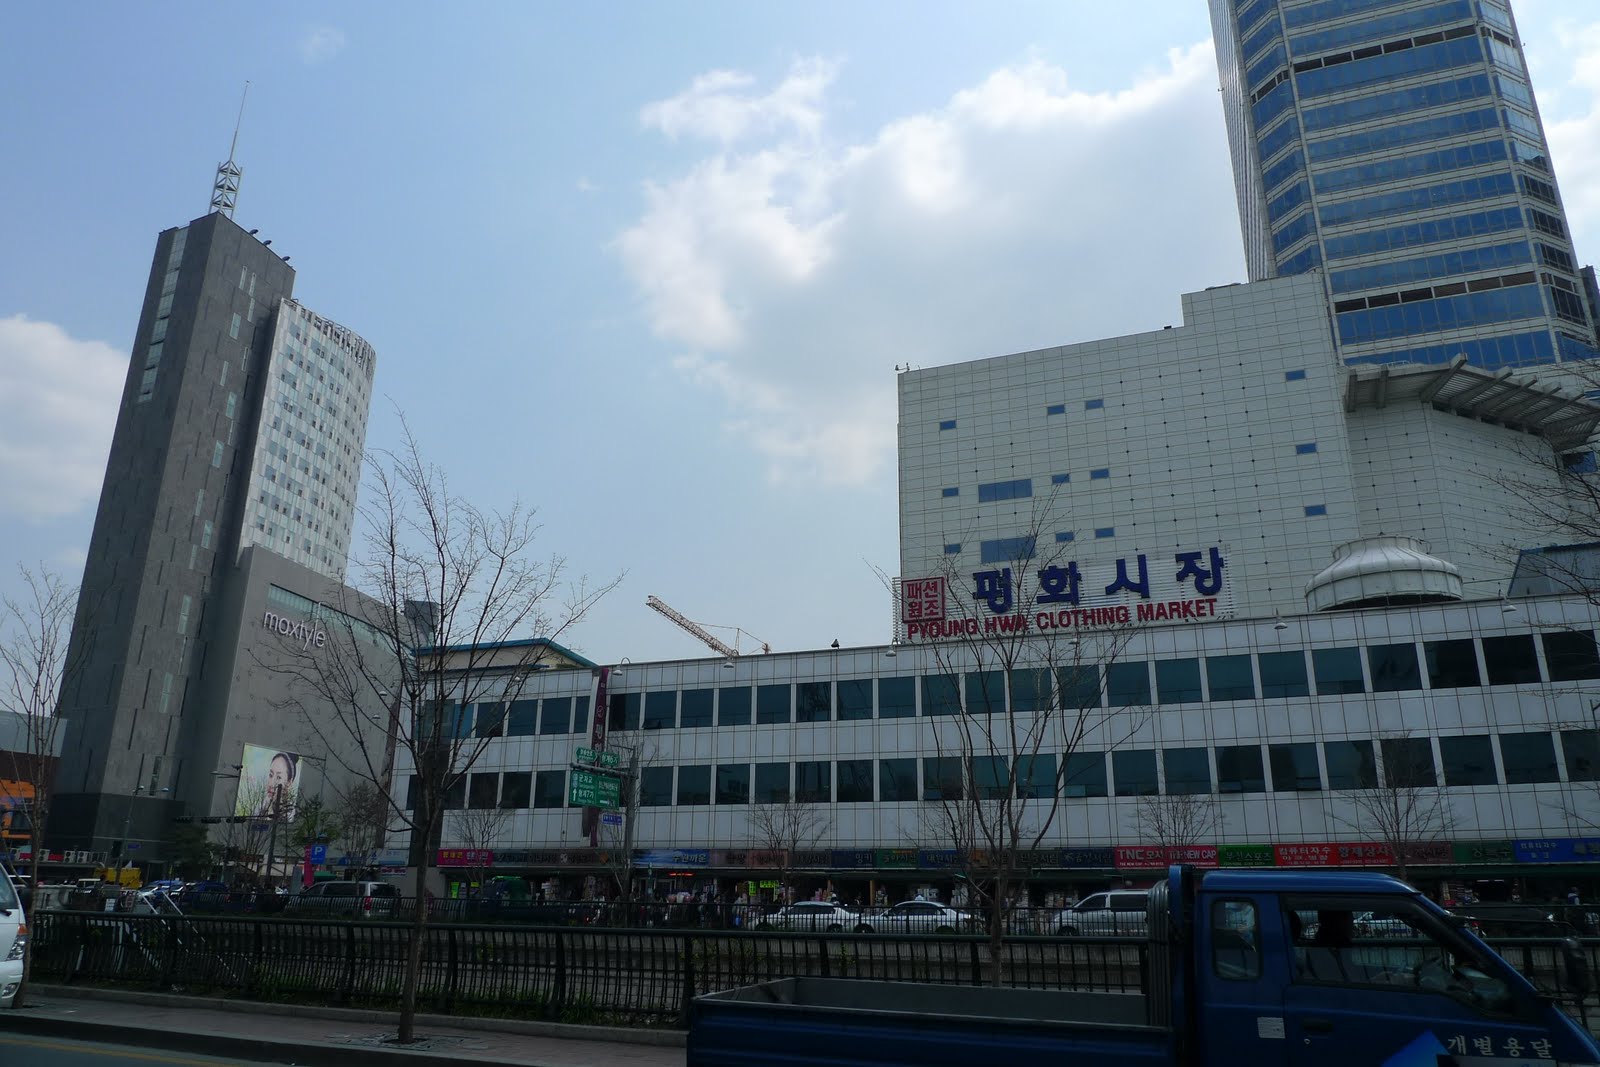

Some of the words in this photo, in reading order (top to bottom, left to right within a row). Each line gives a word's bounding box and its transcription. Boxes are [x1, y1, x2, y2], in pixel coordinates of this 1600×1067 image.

[973, 547, 1224, 614] 평화시장
[907, 581, 938, 600] 패션
[907, 600, 939, 619] 원조
[907, 617, 978, 640] PYOUNG
[985, 614, 1029, 634] HWA
[1036, 605, 1129, 630] CLOTHING
[1137, 598, 1217, 622] MARKET
[1117, 849, 1144, 860] TNC
[1201, 849, 1217, 859] CAP
[1278, 846, 1332, 856] 컴퓨터자수
[1447, 1034, 1552, 1059] 개별용달
